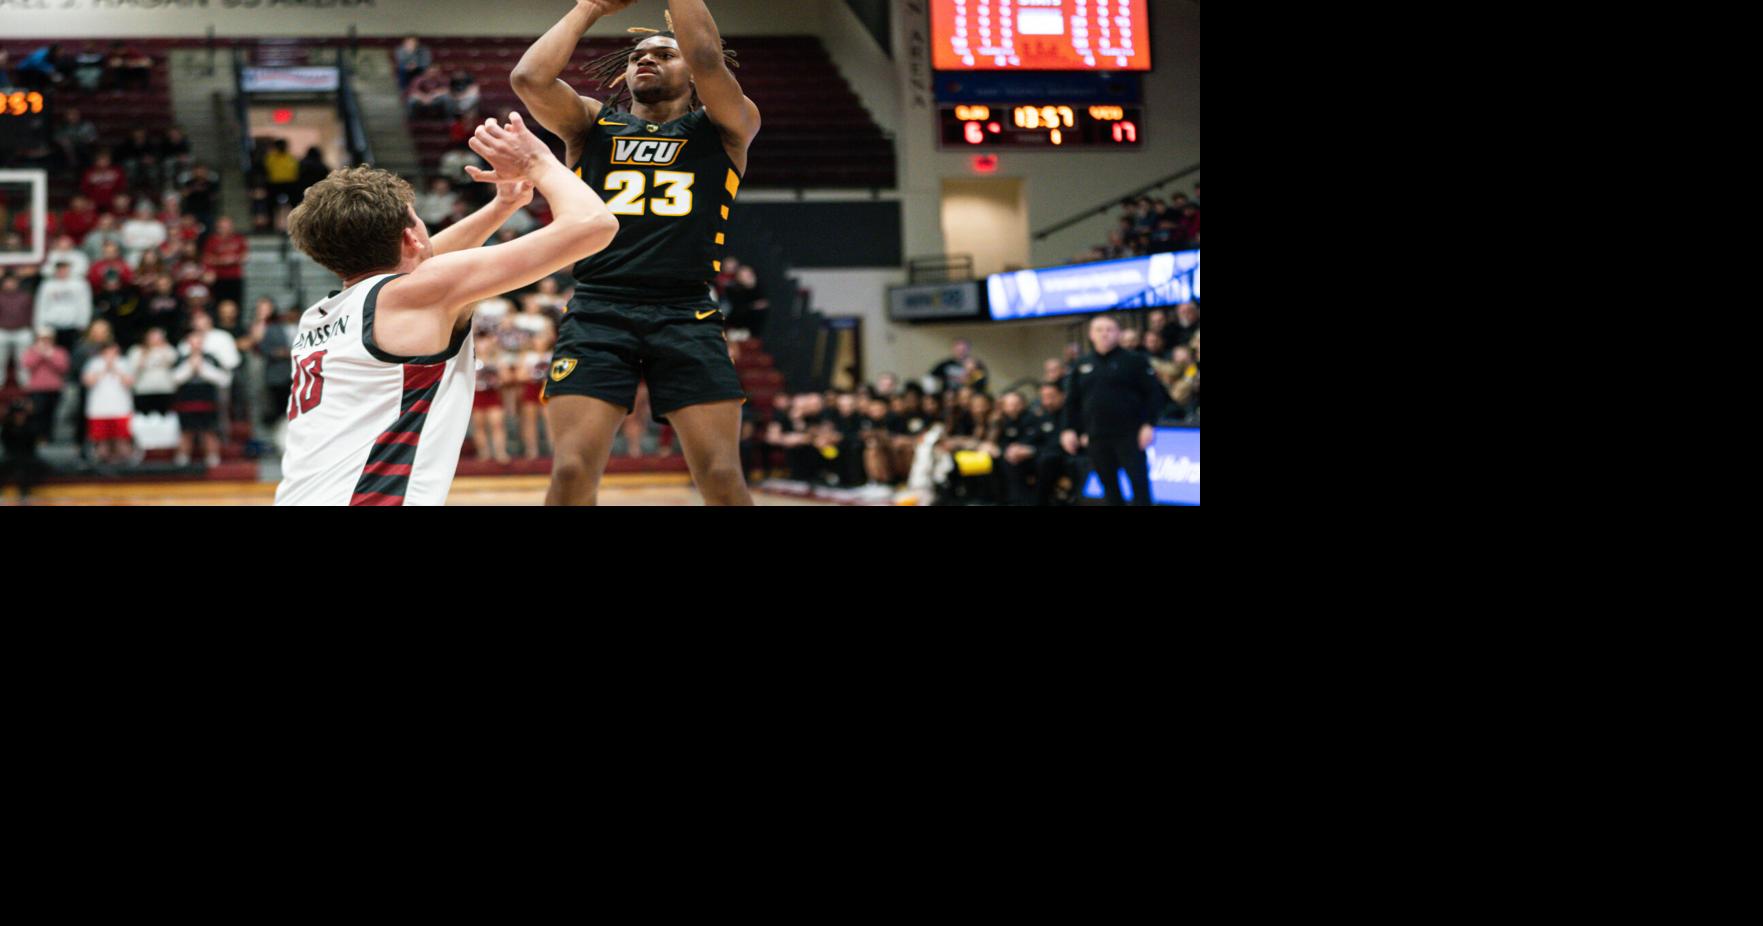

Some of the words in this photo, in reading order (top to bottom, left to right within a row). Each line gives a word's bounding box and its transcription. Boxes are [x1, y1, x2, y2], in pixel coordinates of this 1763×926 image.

[1112, 121, 1136, 143] 17
[613, 138, 682, 164] VCU
[604, 169, 695, 217] 23
[287, 349, 328, 421] 10
